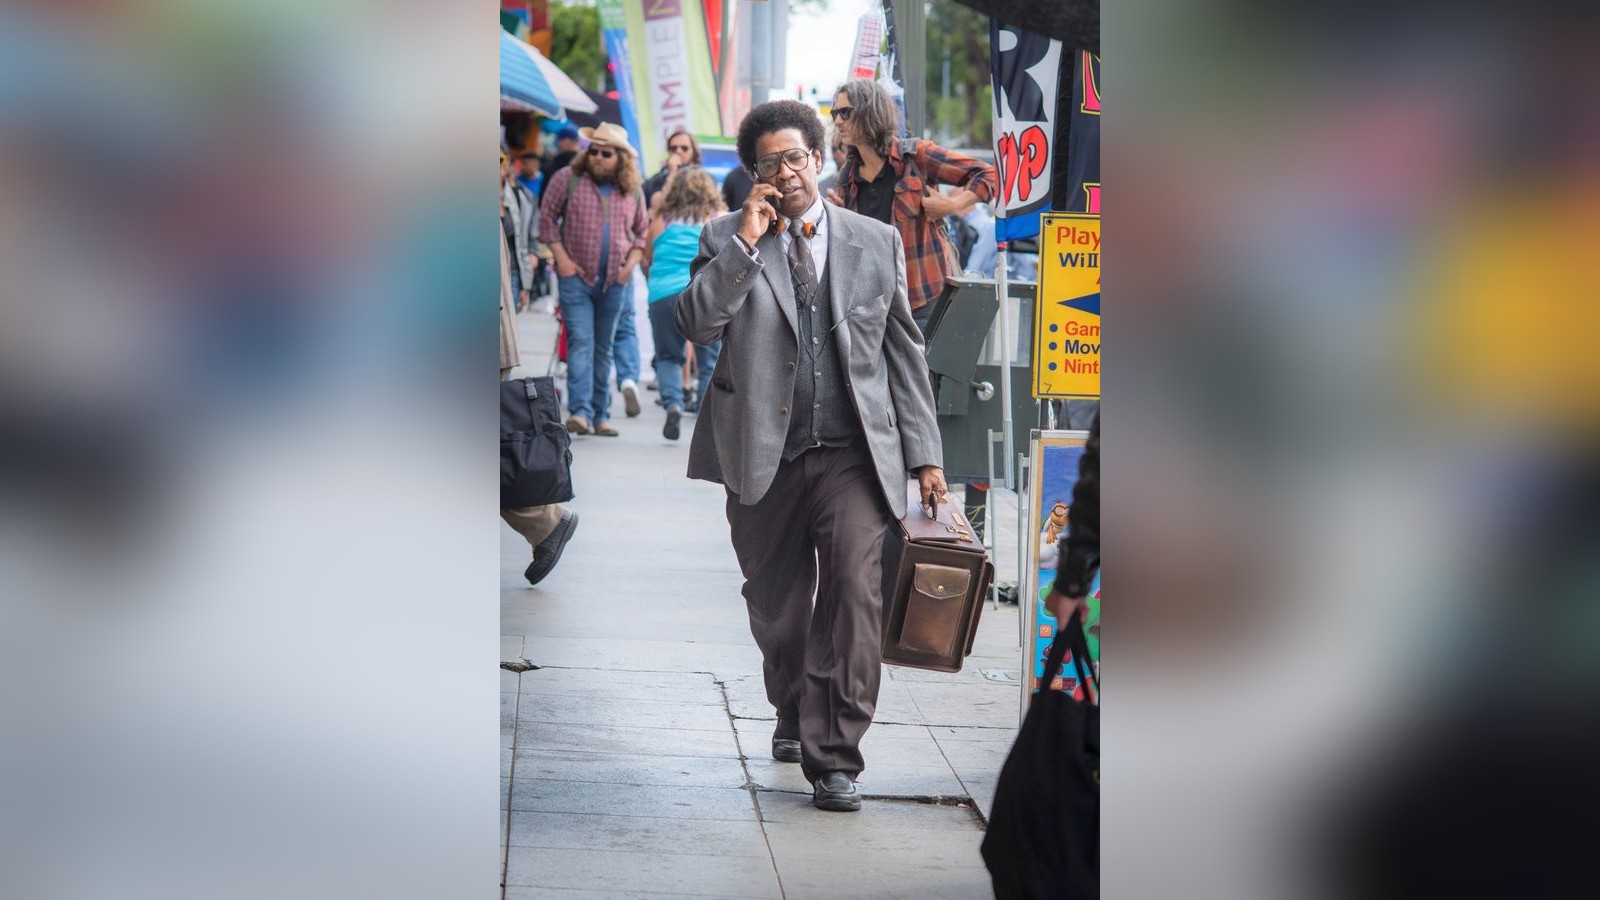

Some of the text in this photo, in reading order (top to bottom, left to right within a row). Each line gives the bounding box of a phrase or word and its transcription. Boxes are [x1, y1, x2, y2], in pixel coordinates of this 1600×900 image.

[1057, 226, 1100, 251] Play
[1064, 340, 1100, 354] Mov
[1064, 359, 1100, 374] Nint
